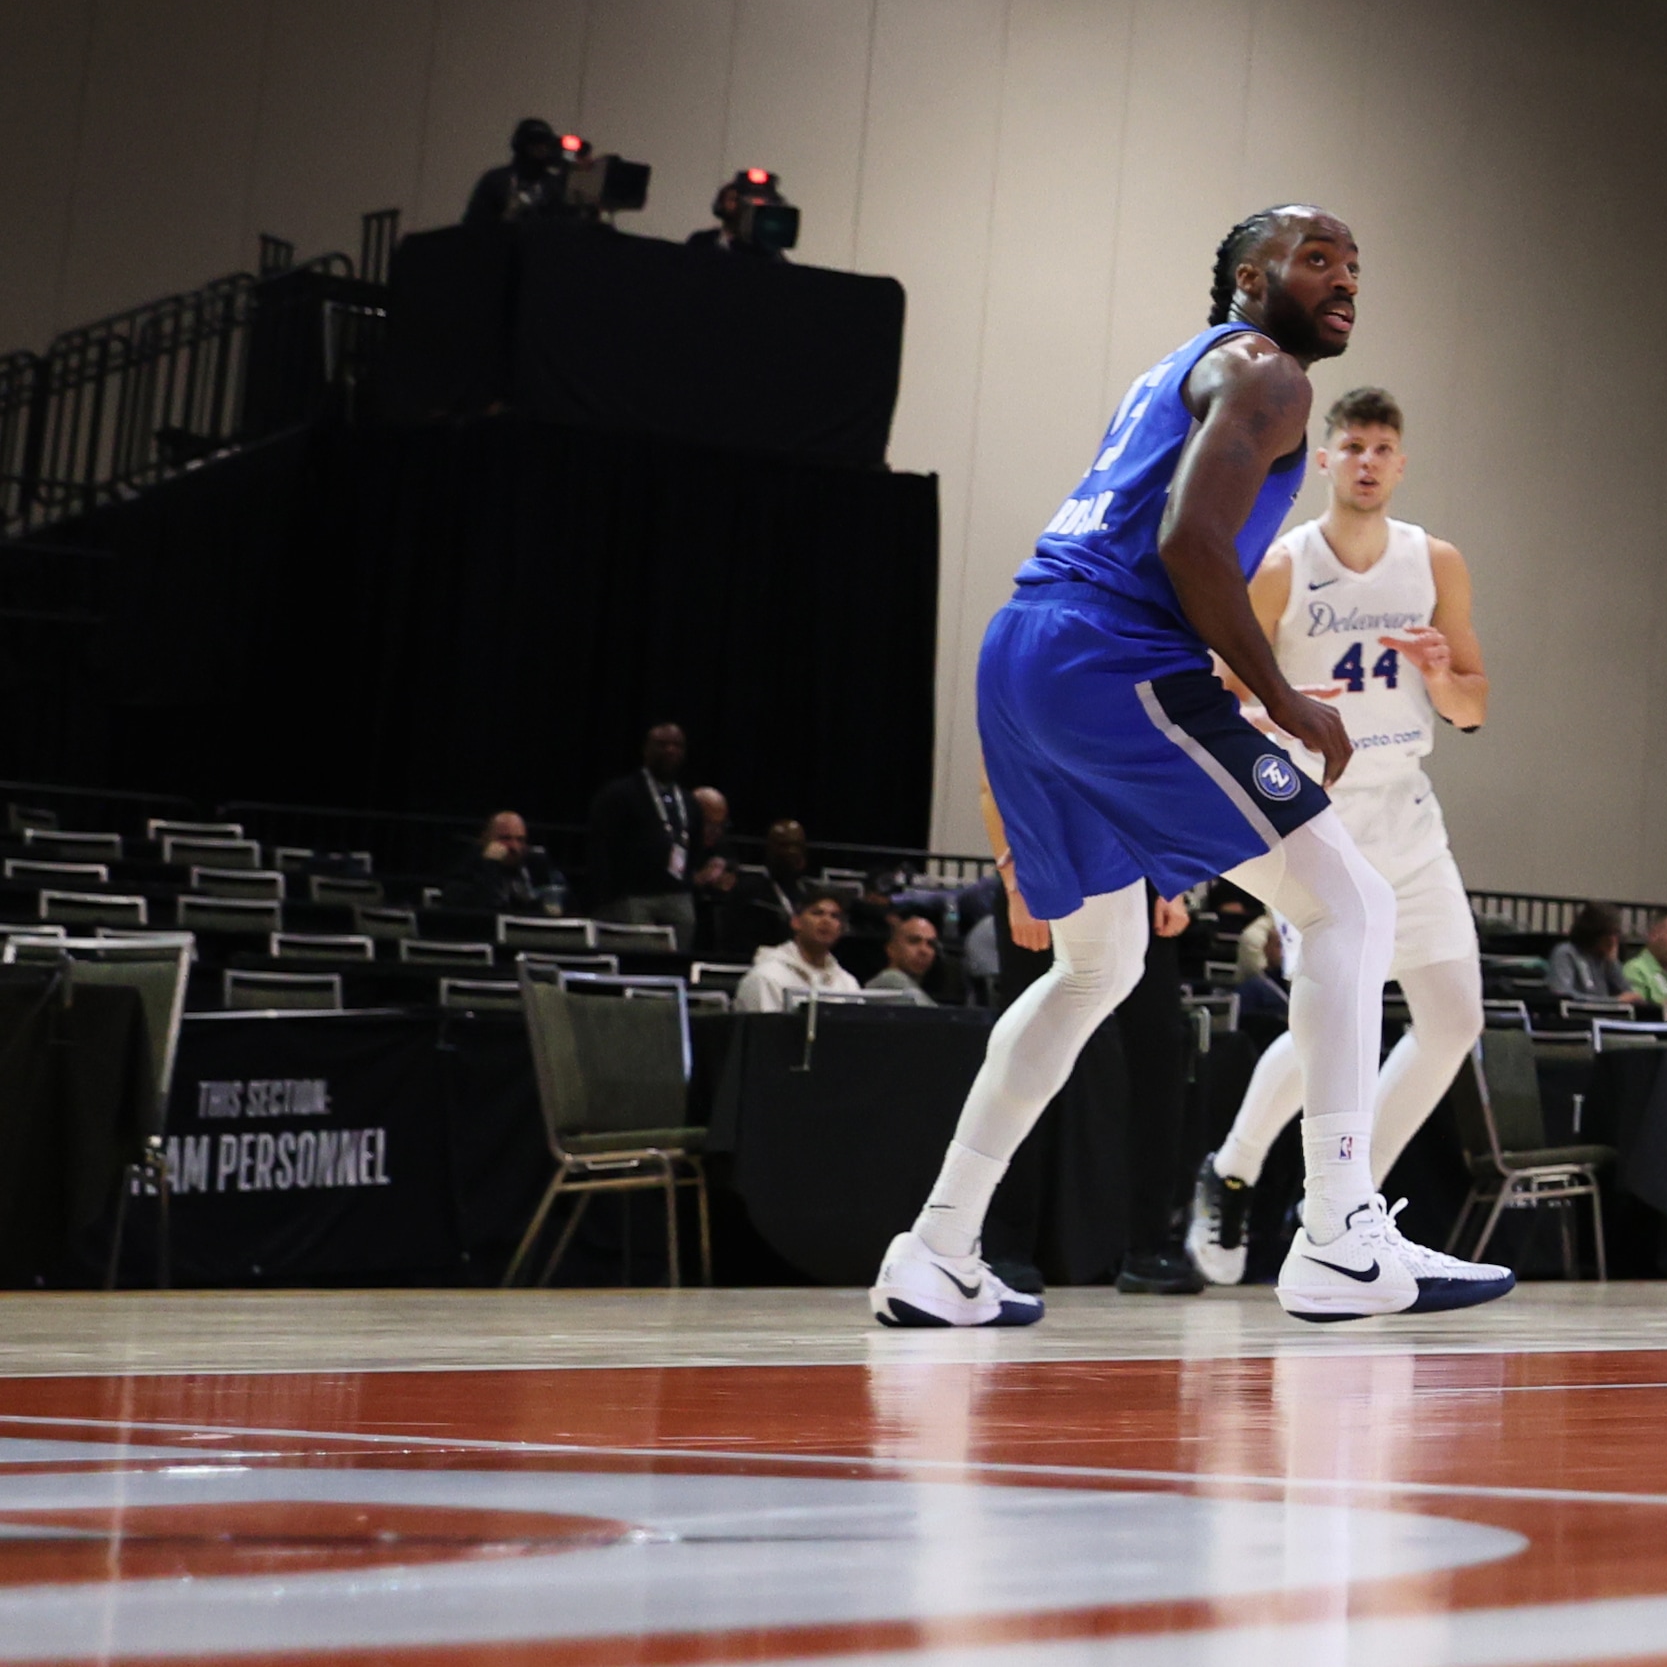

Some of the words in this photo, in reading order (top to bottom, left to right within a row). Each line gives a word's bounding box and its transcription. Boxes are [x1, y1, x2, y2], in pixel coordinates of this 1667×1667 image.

[1332, 642, 1400, 692] 44
[1351, 730, 1421, 751] ypto.com
[199, 1080, 243, 1118] THIS
[216, 1128, 391, 1192] PERSONNEL
